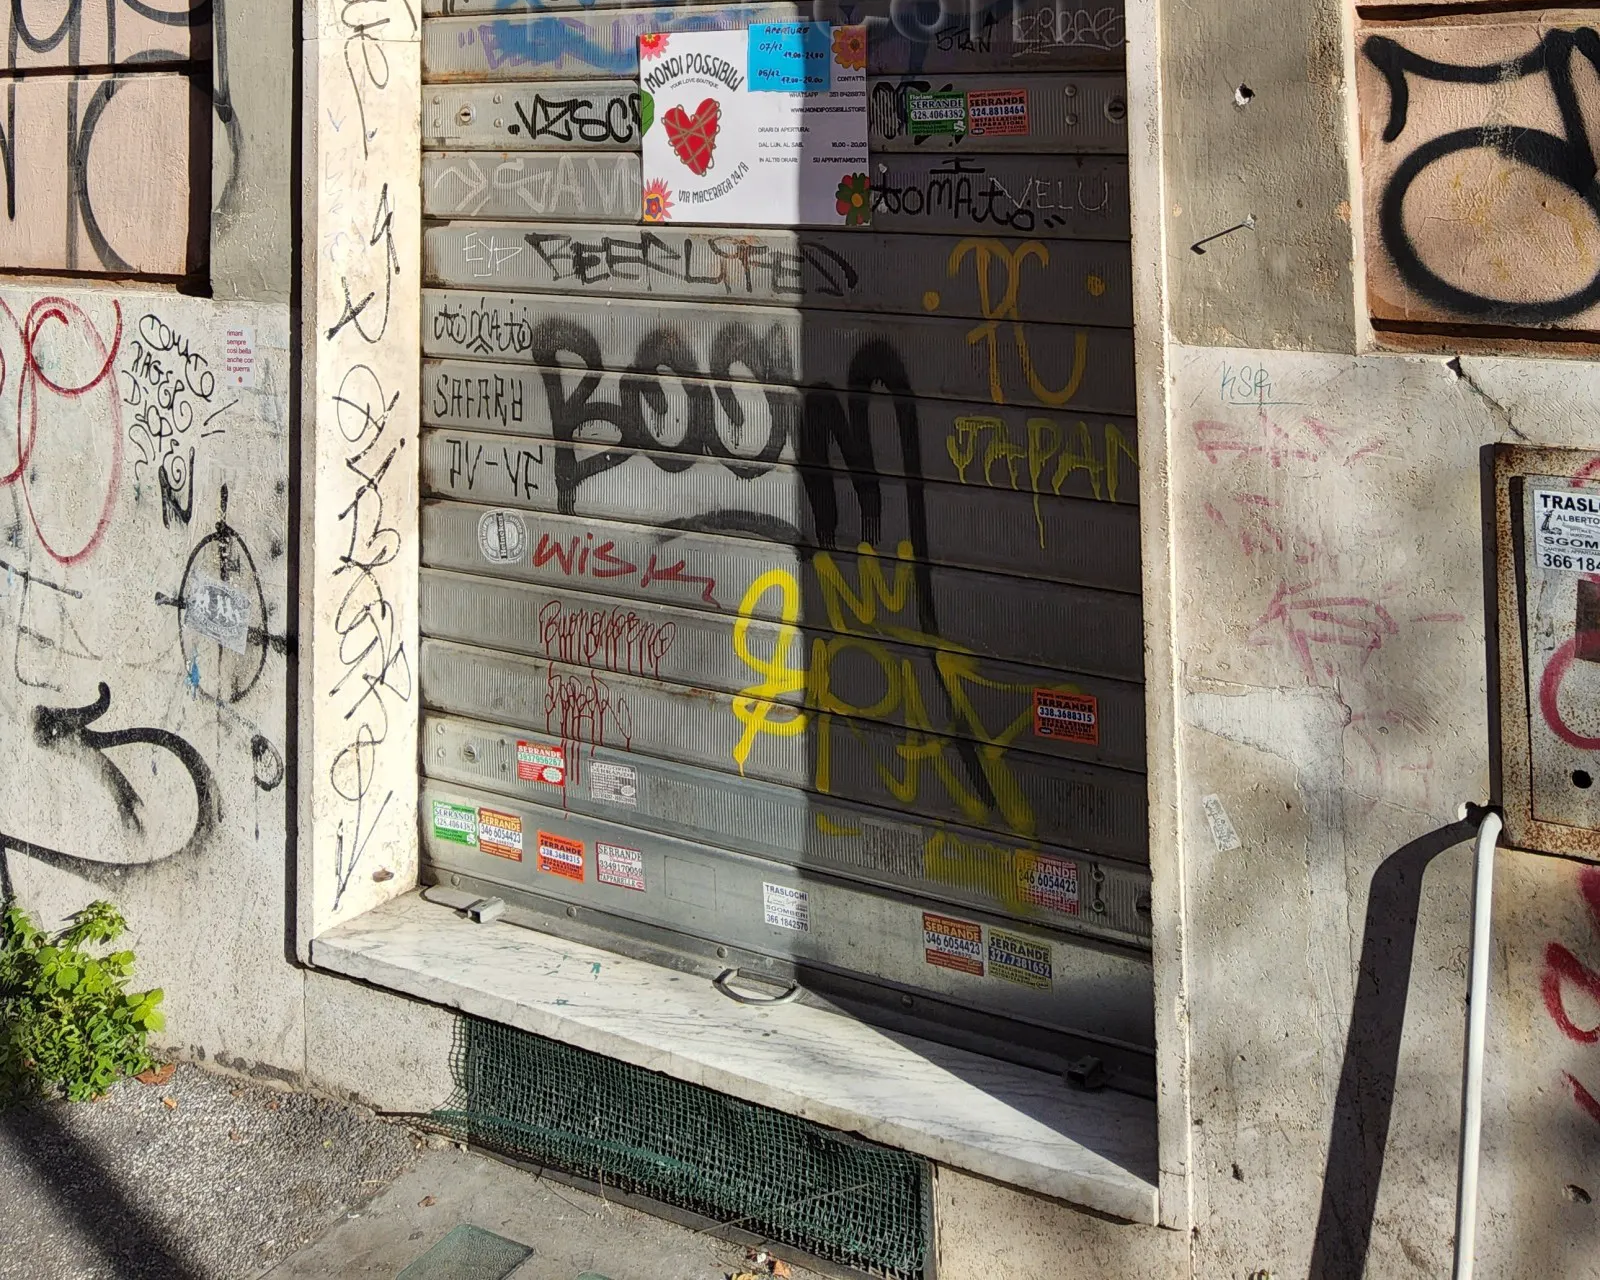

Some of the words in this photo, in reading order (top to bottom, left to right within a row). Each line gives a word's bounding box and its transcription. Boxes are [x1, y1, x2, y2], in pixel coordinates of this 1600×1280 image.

[644, 55, 684, 94] MONDI
[686, 53, 744, 92] POSSIBILI
[911, 99, 964, 109] SERRANDE
[969, 97, 1025, 107] SERRANDE
[912, 109, 964, 120] 328.4064382
[971, 105, 1025, 117] 324.8818464
[679, 189, 690, 203] VIA
[692, 177, 734, 204] MACERATA
[1540, 494, 1600, 513] TRASL
[1556, 514, 1600, 525] ALBERTO
[1543, 553, 1572, 569] 366
[1037, 697, 1094, 713] SERRANDE
[1040, 707, 1092, 722] 338.3688315
[518, 746, 562, 758] SERRANDE
[435, 807, 473, 821] SERRANDE
[481, 815, 521, 832] SERRANDE
[481, 824, 492, 837] 346
[540, 839, 582, 856] SERRANDE
[599, 844, 643, 861] SERRANDE
[1038, 873, 1076, 893] 6054423
[765, 884, 808, 901] TRASLOCHI
[766, 913, 778, 924] 366
[925, 921, 980, 941] SERRANDE
[925, 932, 942, 946] 346
[943, 936, 980, 955] 6054423
[990, 936, 1049, 963] SERRANDE
